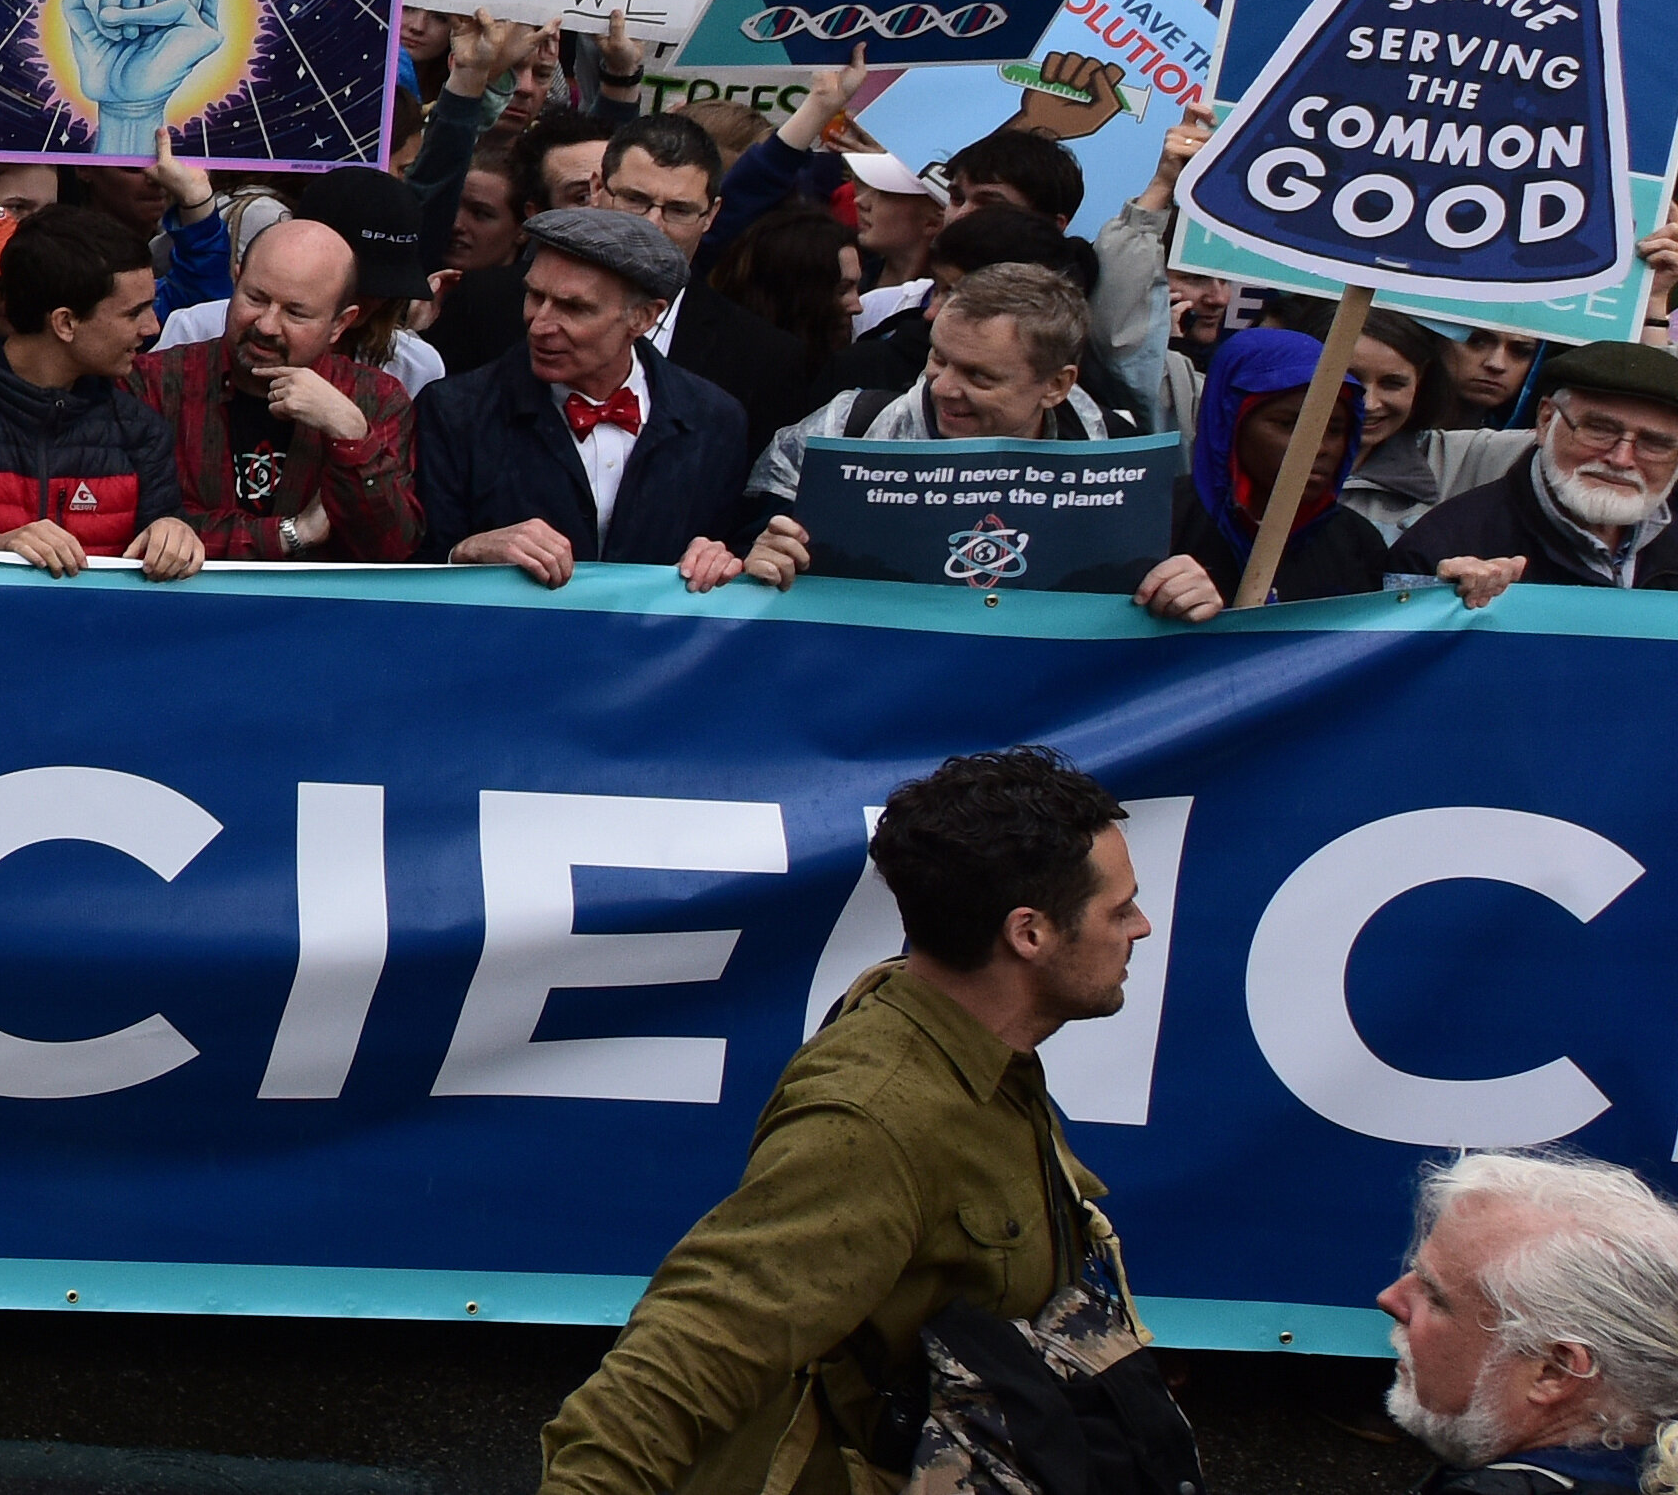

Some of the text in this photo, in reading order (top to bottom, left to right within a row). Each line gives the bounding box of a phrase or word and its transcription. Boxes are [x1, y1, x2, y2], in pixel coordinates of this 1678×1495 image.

[1346, 25, 1580, 90] SERVING
[1406, 76, 1481, 110] THE
[1288, 96, 1582, 169] COMMON
[1246, 146, 1586, 248] GOOD
[840, 464, 1146, 485] There will never be a better
[866, 487, 1124, 508] time to save the planet
